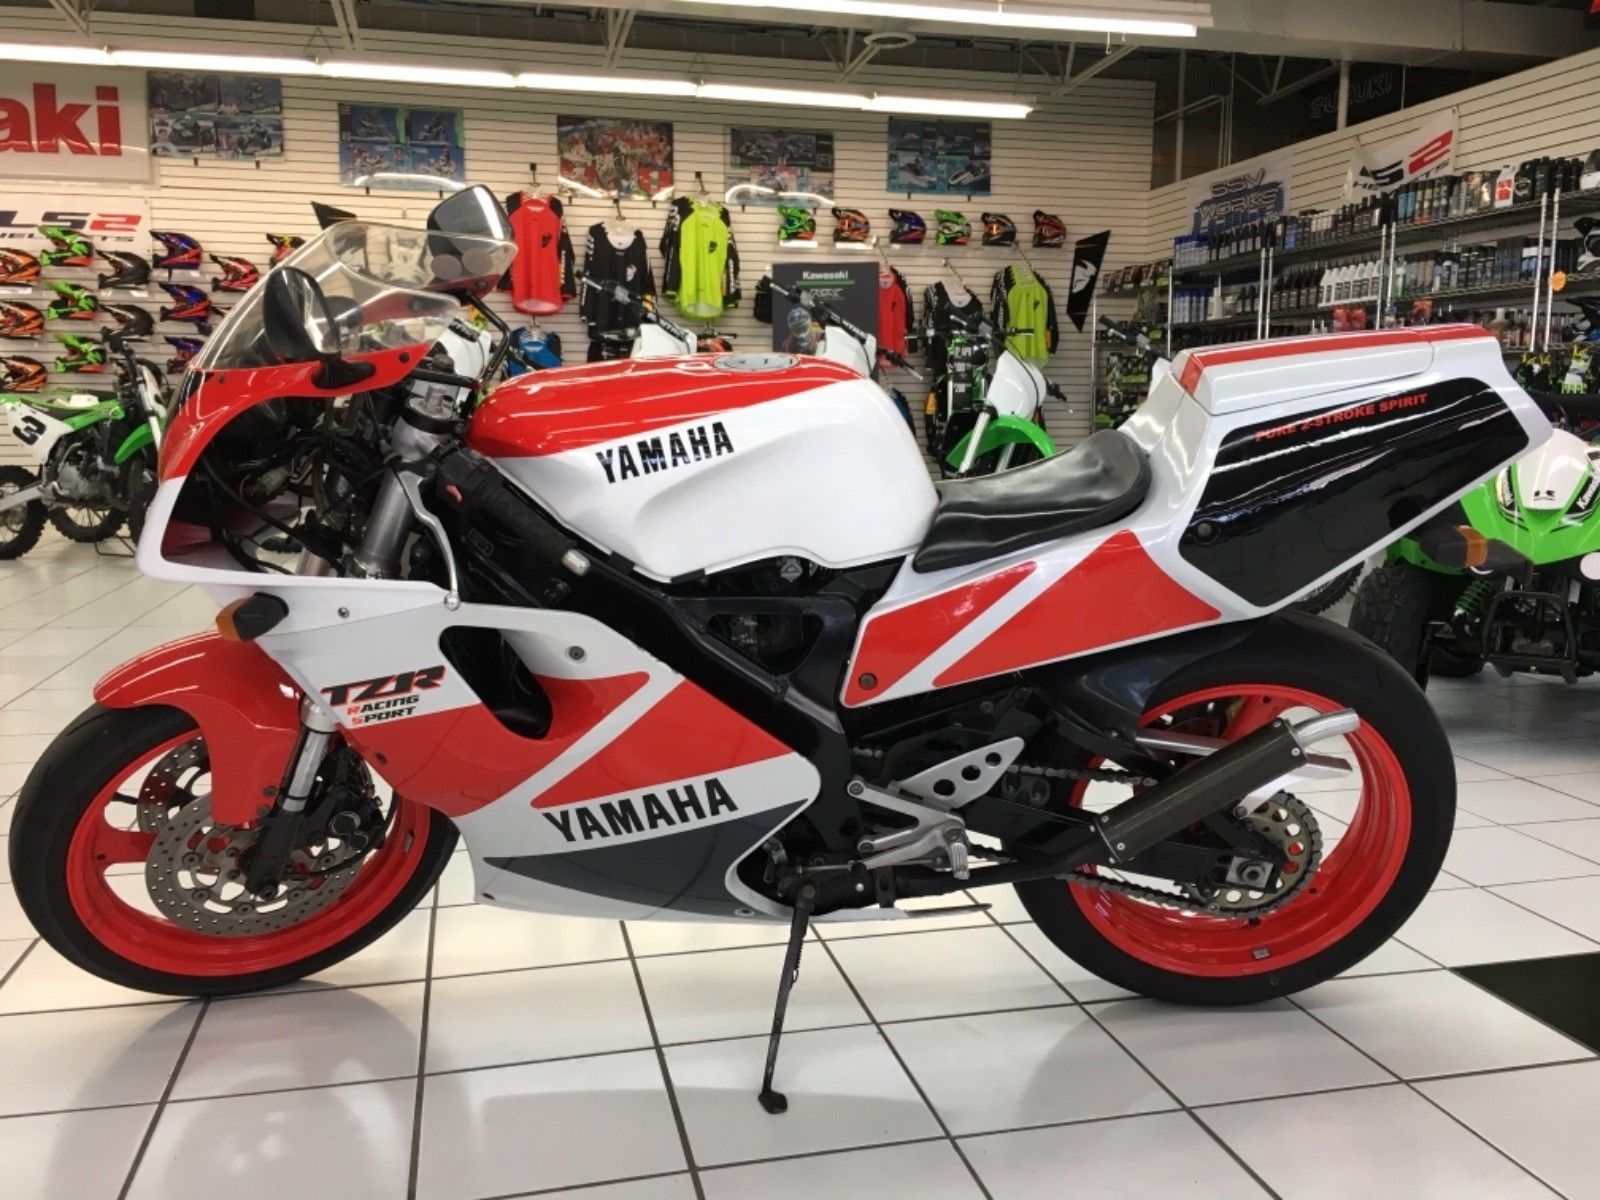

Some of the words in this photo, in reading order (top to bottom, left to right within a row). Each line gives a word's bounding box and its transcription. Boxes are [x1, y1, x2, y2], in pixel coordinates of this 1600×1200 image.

[1209, 167, 1266, 198] SSV
[802, 271, 849, 281] Kawasaki
[1255, 421, 1297, 443] PURE
[1301, 403, 1376, 432] 2-STROKE
[1379, 392, 1428, 412] SPIRIT
[595, 421, 735, 484] YAMAHA
[320, 664, 446, 706] TZR
[347, 694, 420, 715] RACING
[352, 706, 416, 725] SPORT
[542, 777, 739, 842] YAMAHA
